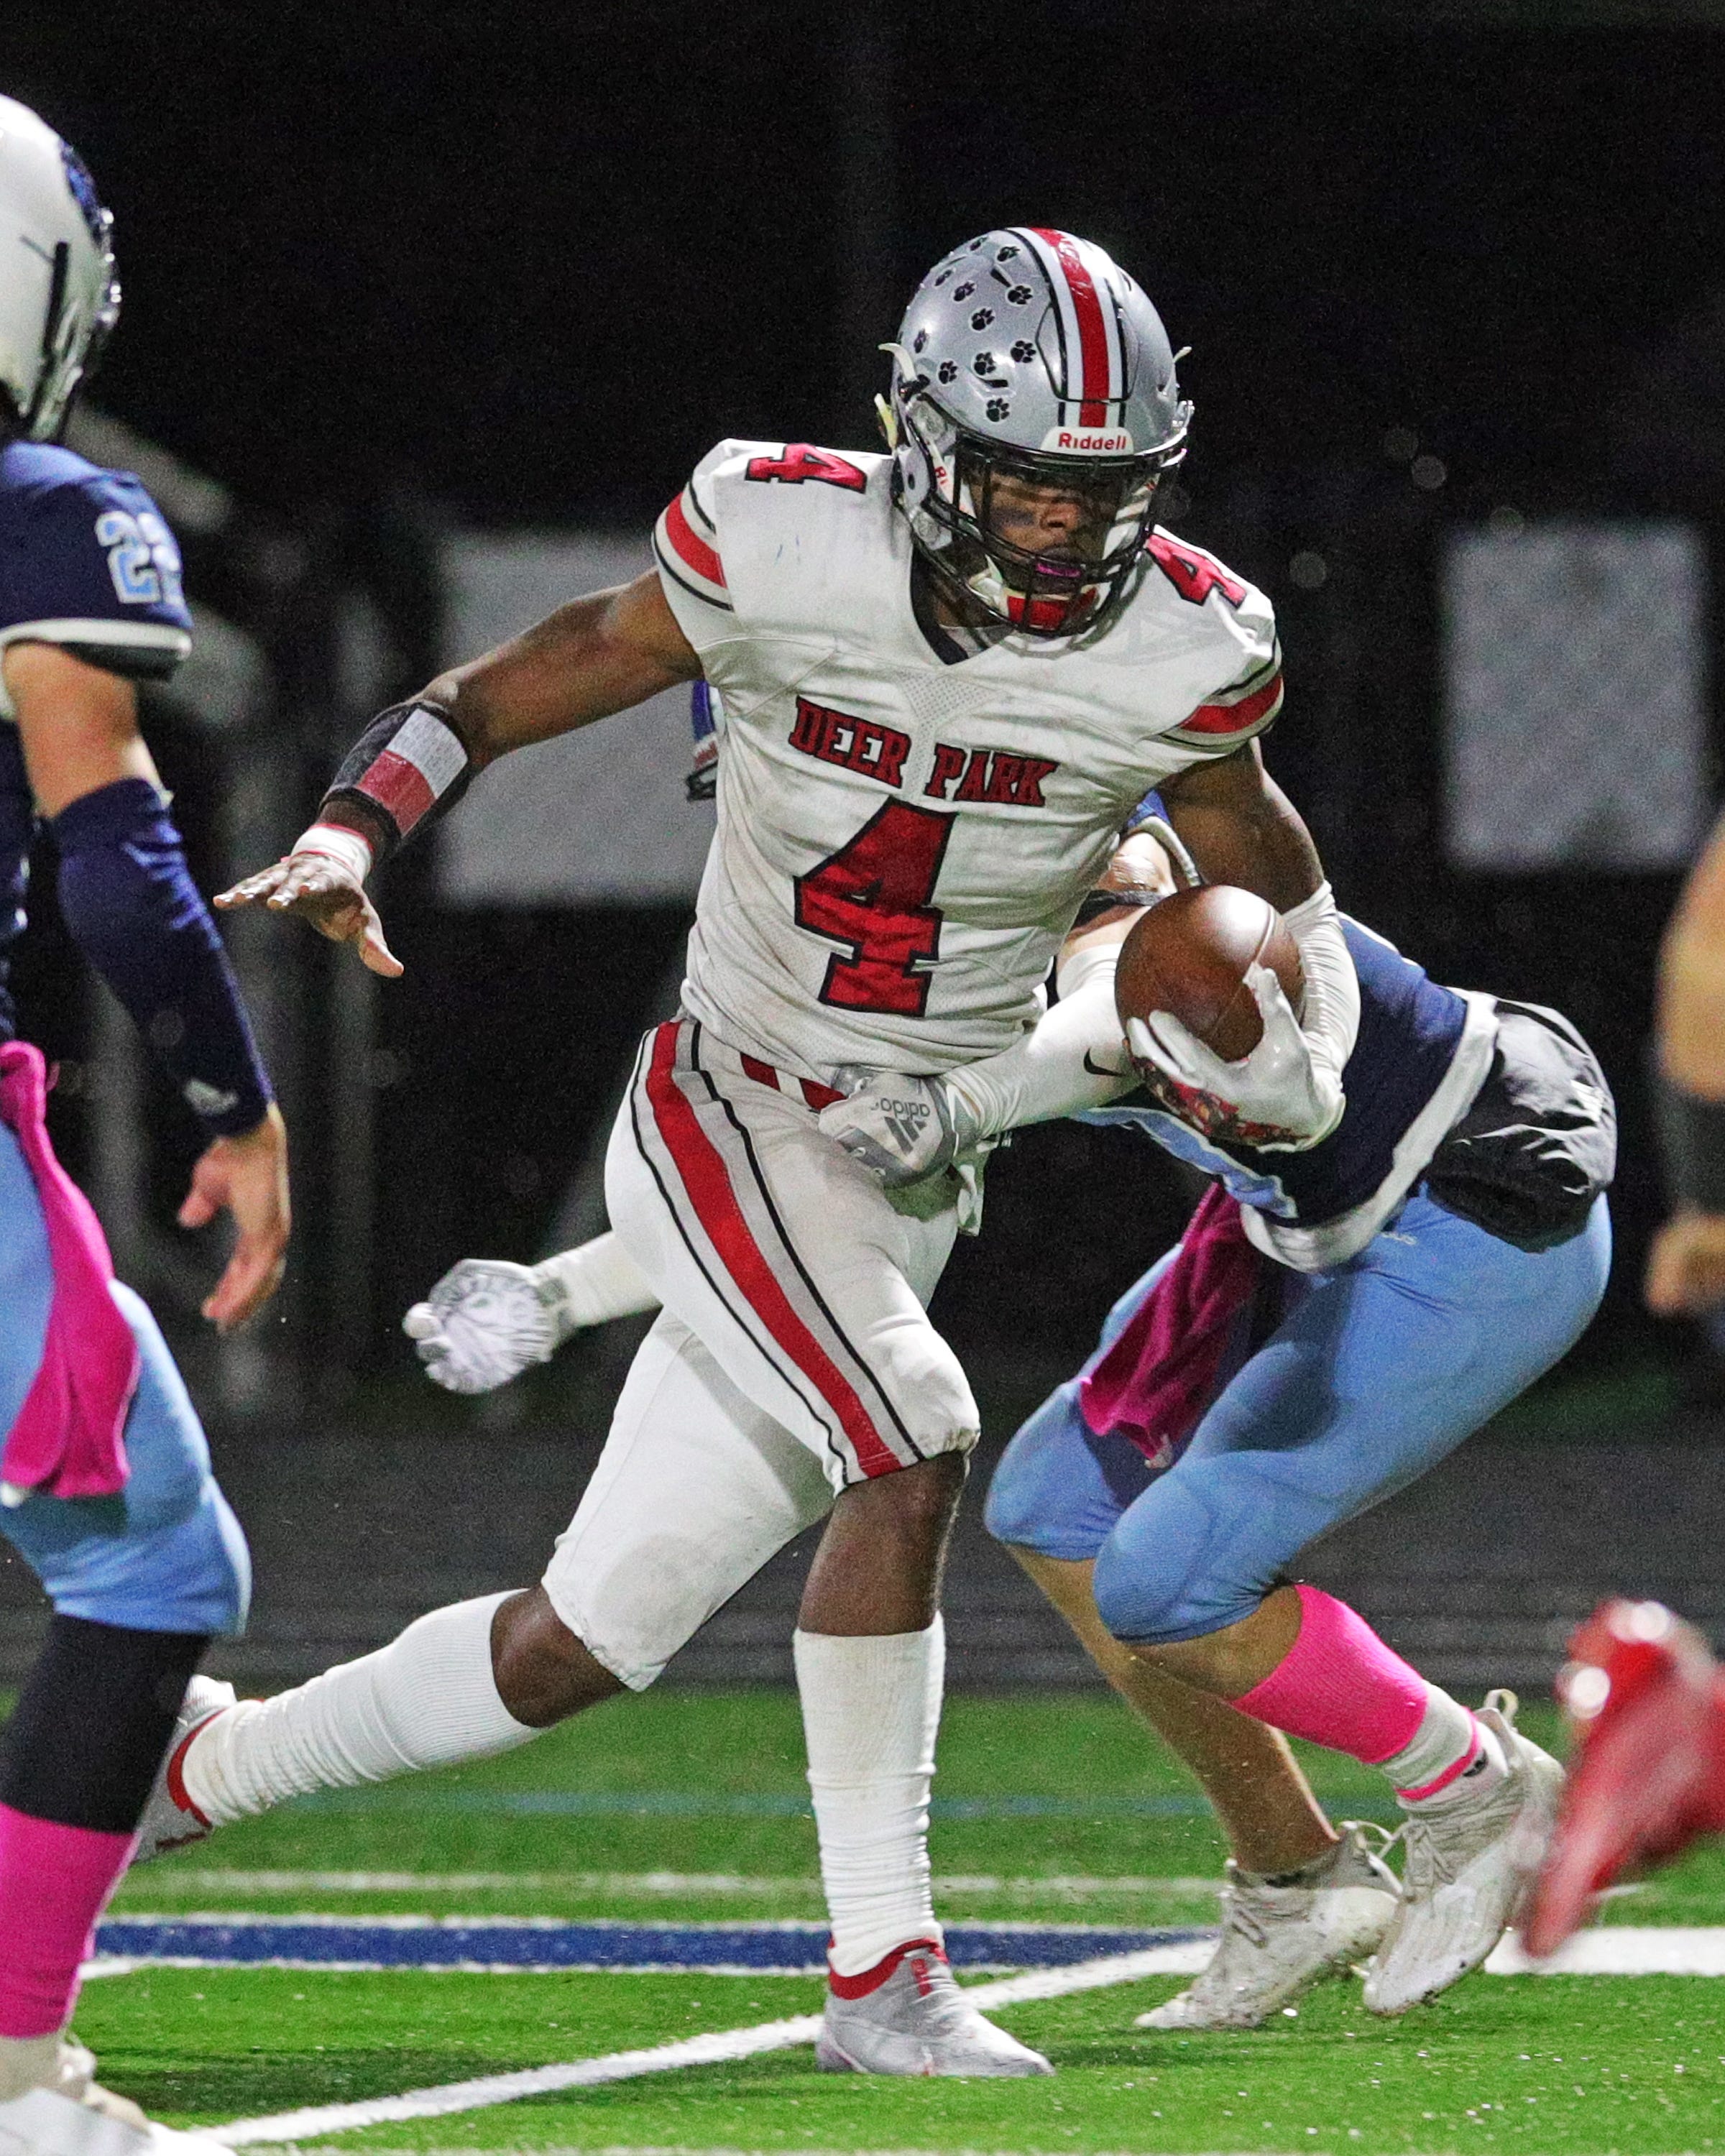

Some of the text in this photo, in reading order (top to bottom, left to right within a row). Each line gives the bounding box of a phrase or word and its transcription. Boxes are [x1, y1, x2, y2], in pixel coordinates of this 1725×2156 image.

[745, 443, 868, 494] 4
[1058, 431, 1127, 450] Riddell
[1146, 533, 1247, 609] 4
[788, 694, 1059, 806] DEER PARK
[792, 795, 958, 1017] 4
